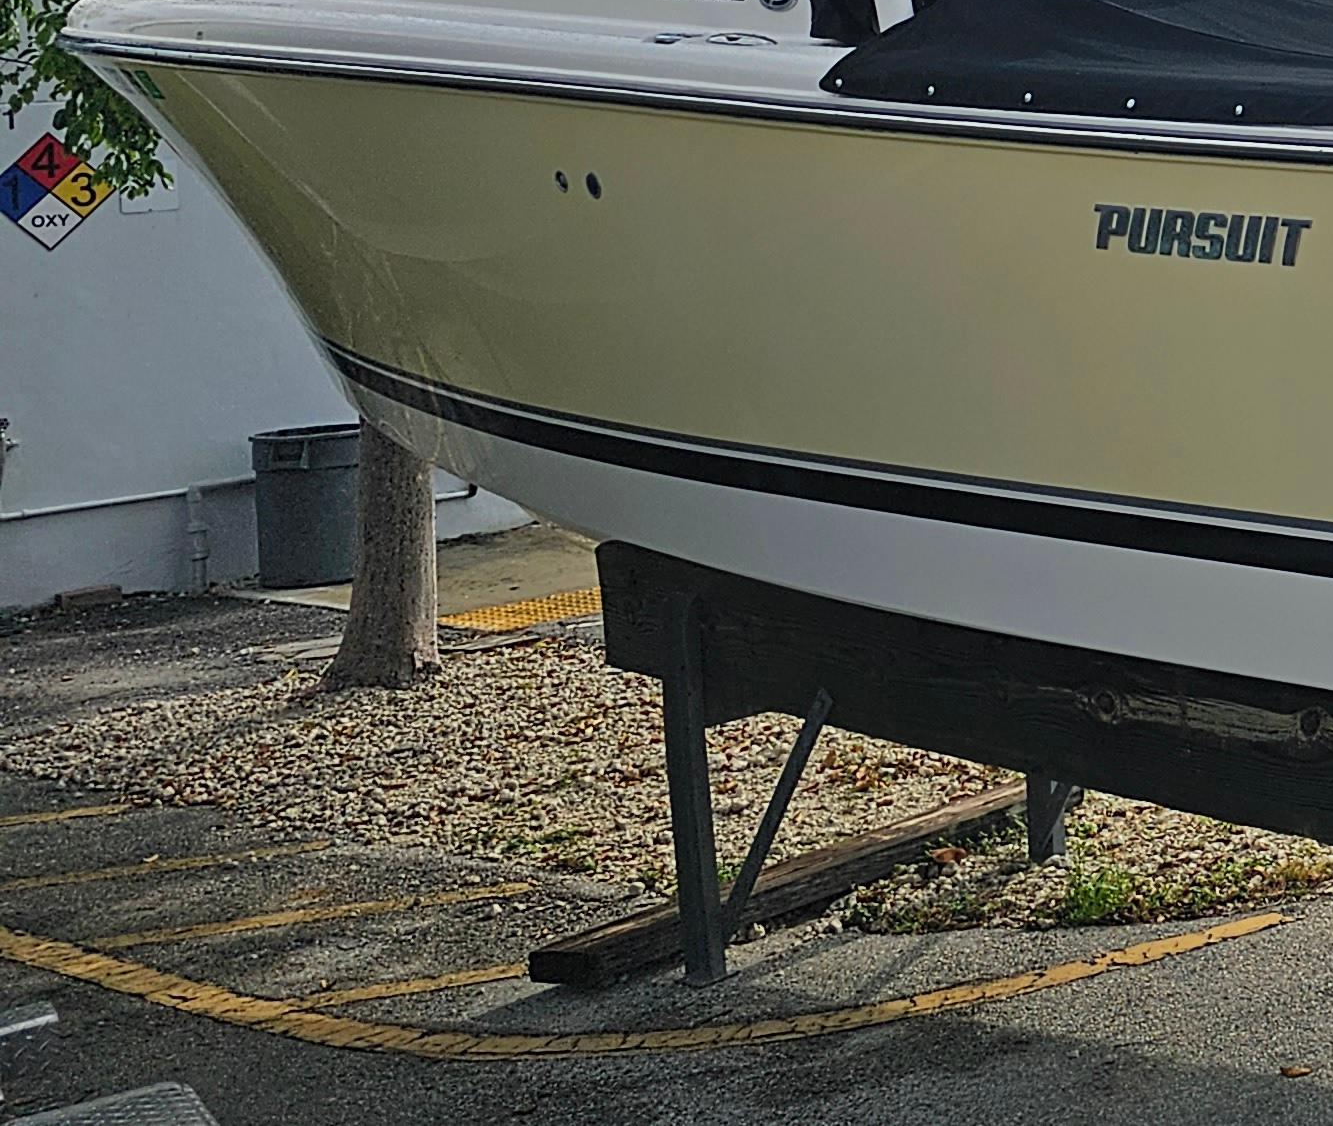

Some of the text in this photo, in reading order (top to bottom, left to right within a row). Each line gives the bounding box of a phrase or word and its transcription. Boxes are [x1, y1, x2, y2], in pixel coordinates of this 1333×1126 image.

[31, 142, 62, 178] 4
[2, 174, 20, 210] 1
[70, 172, 97, 207] 3
[31, 213, 70, 228] OXY
[1094, 203, 1313, 267] PURSUIT
